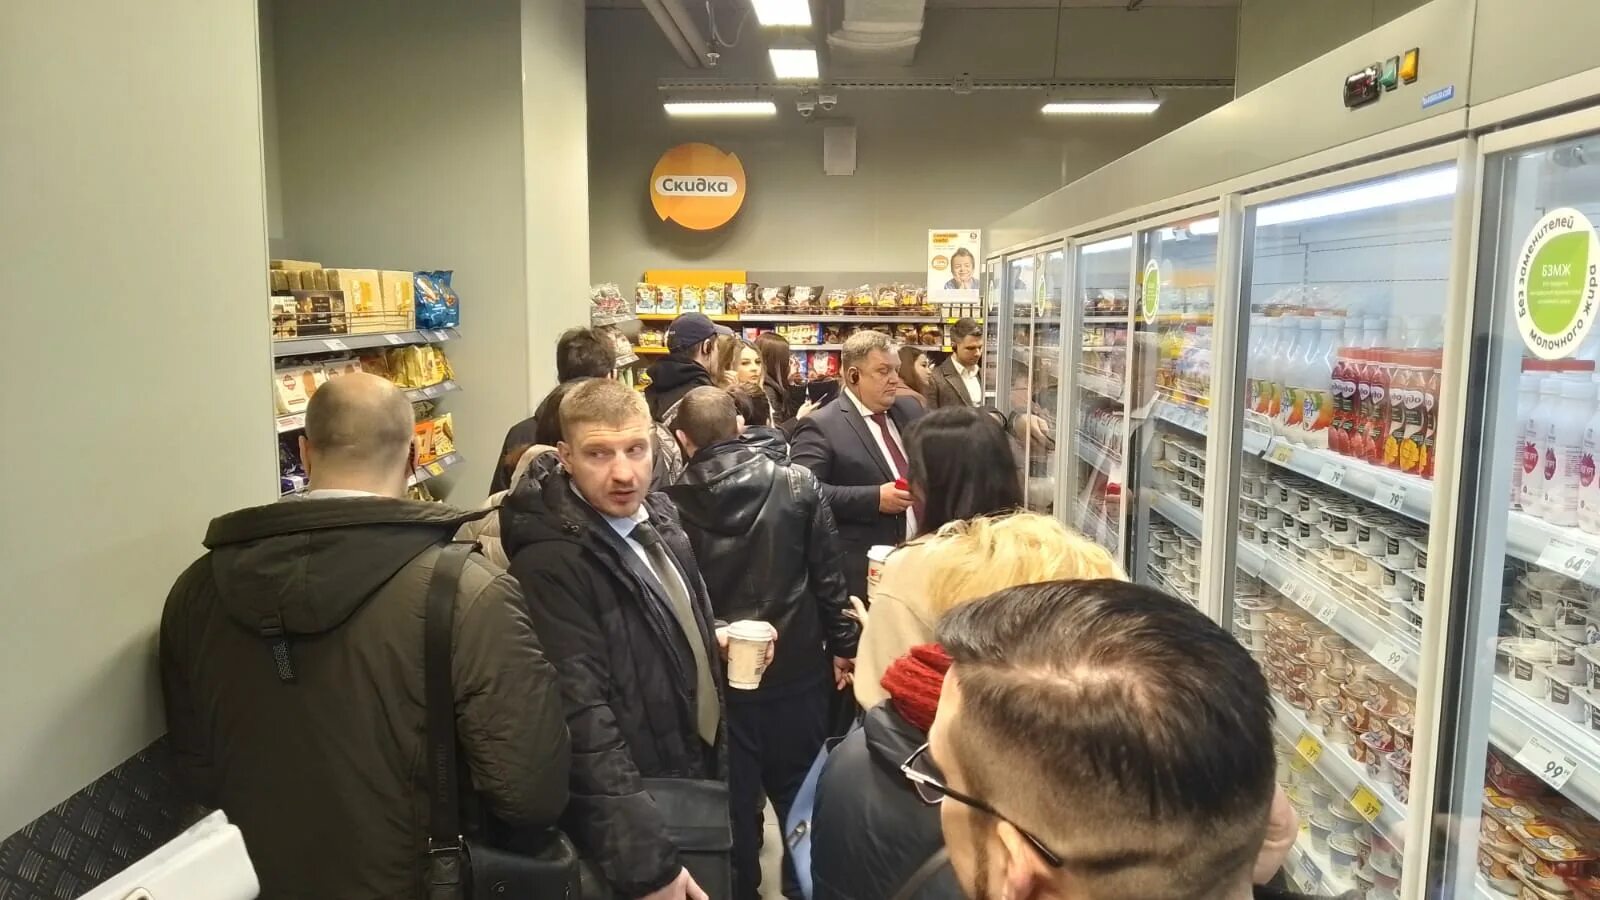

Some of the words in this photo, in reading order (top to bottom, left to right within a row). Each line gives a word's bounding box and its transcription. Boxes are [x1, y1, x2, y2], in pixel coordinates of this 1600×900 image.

[662, 178, 728, 193] Скидка
[1518, 215, 1574, 285] заменителей
[1542, 264, 1571, 277] БЗМЖ
[1529, 319, 1584, 350] молочного
[1584, 264, 1598, 316] жира
[1544, 761, 1563, 778] 99
